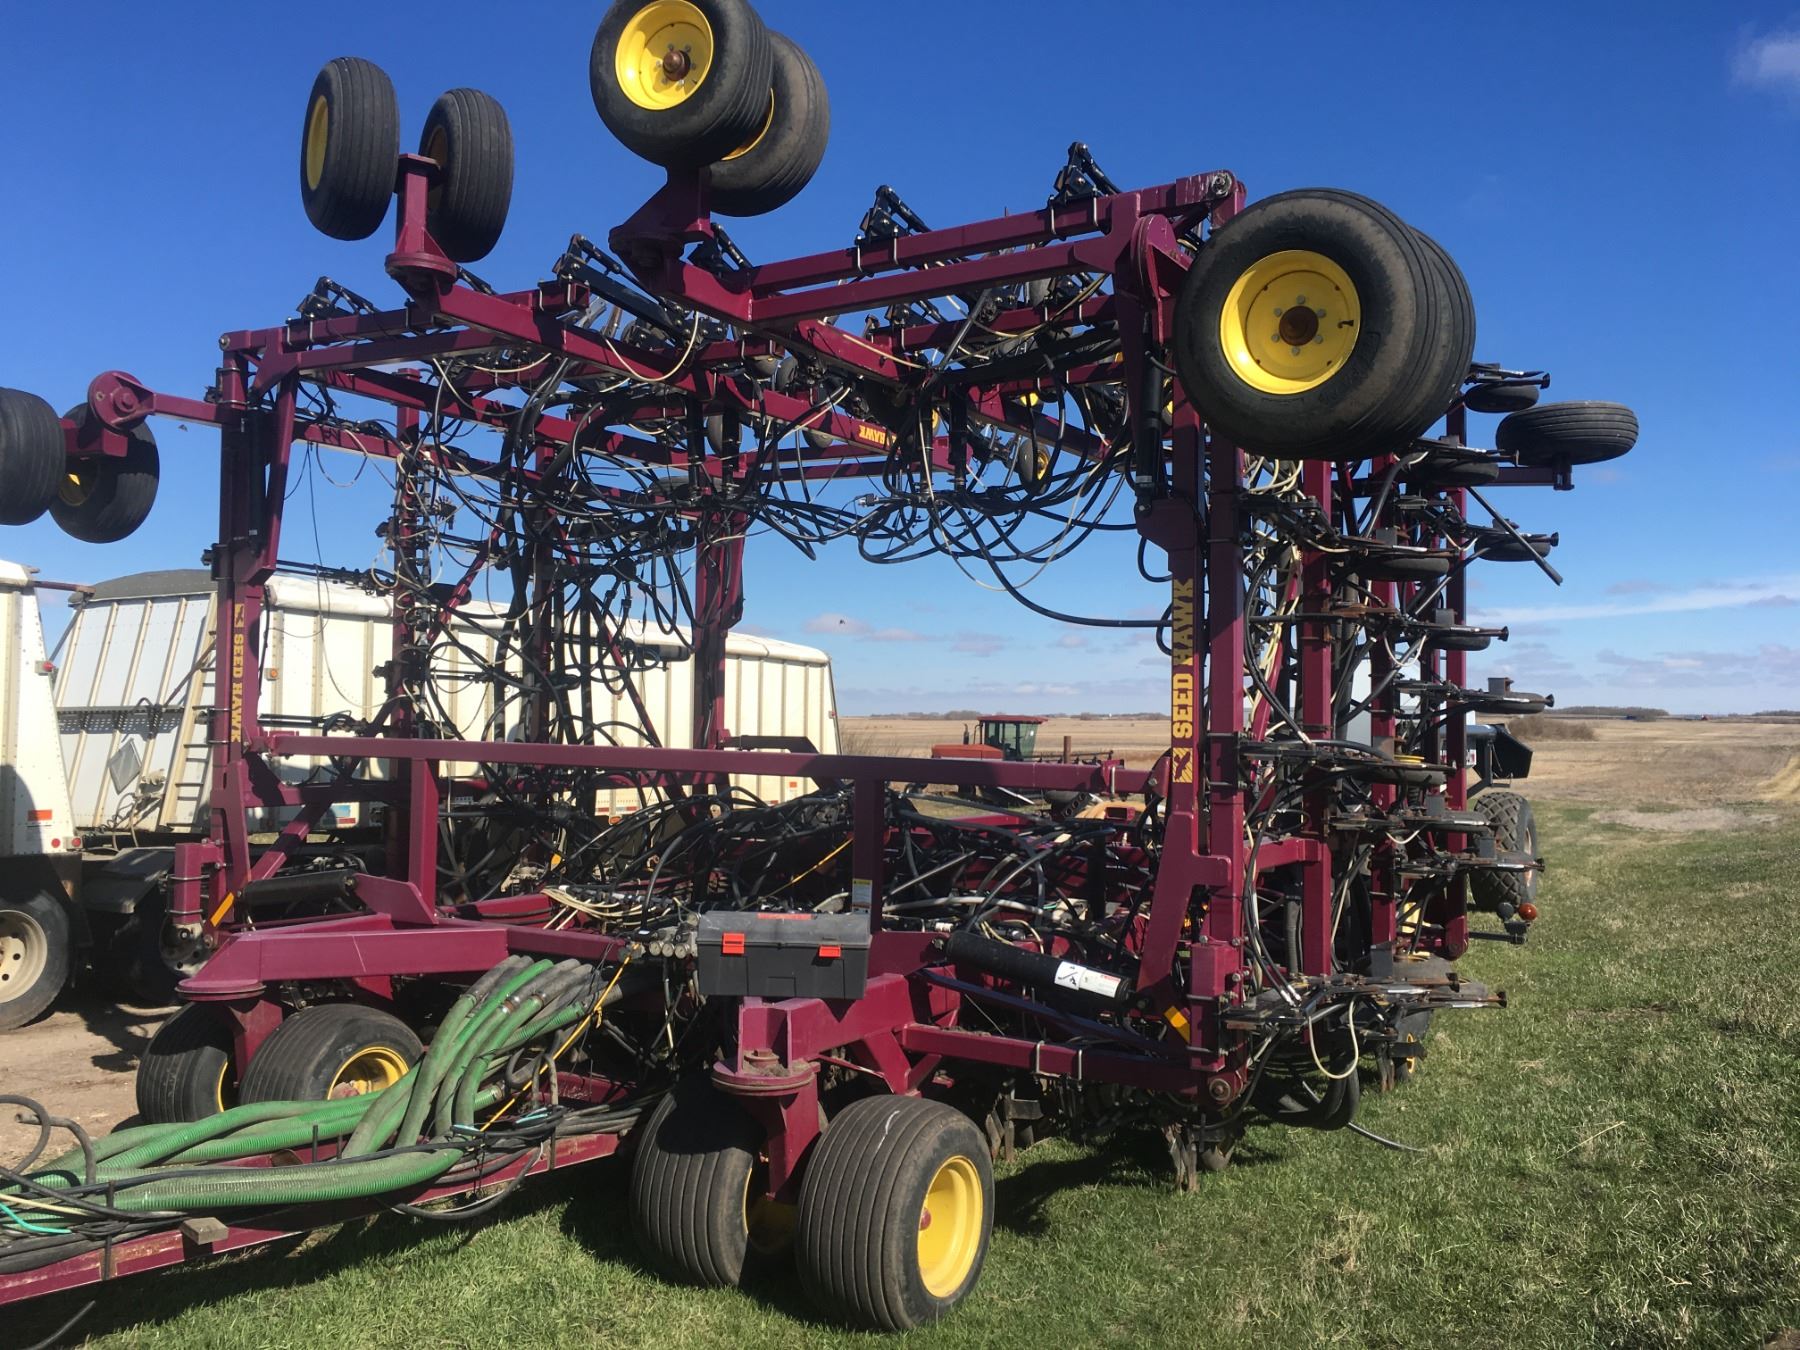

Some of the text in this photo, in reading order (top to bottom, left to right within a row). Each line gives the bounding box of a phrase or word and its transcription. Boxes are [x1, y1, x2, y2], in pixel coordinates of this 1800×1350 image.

[858, 424, 886, 445] HAWK
[231, 633, 244, 743] SEED HAWK
[1172, 578, 1194, 739] SEED HAWK
